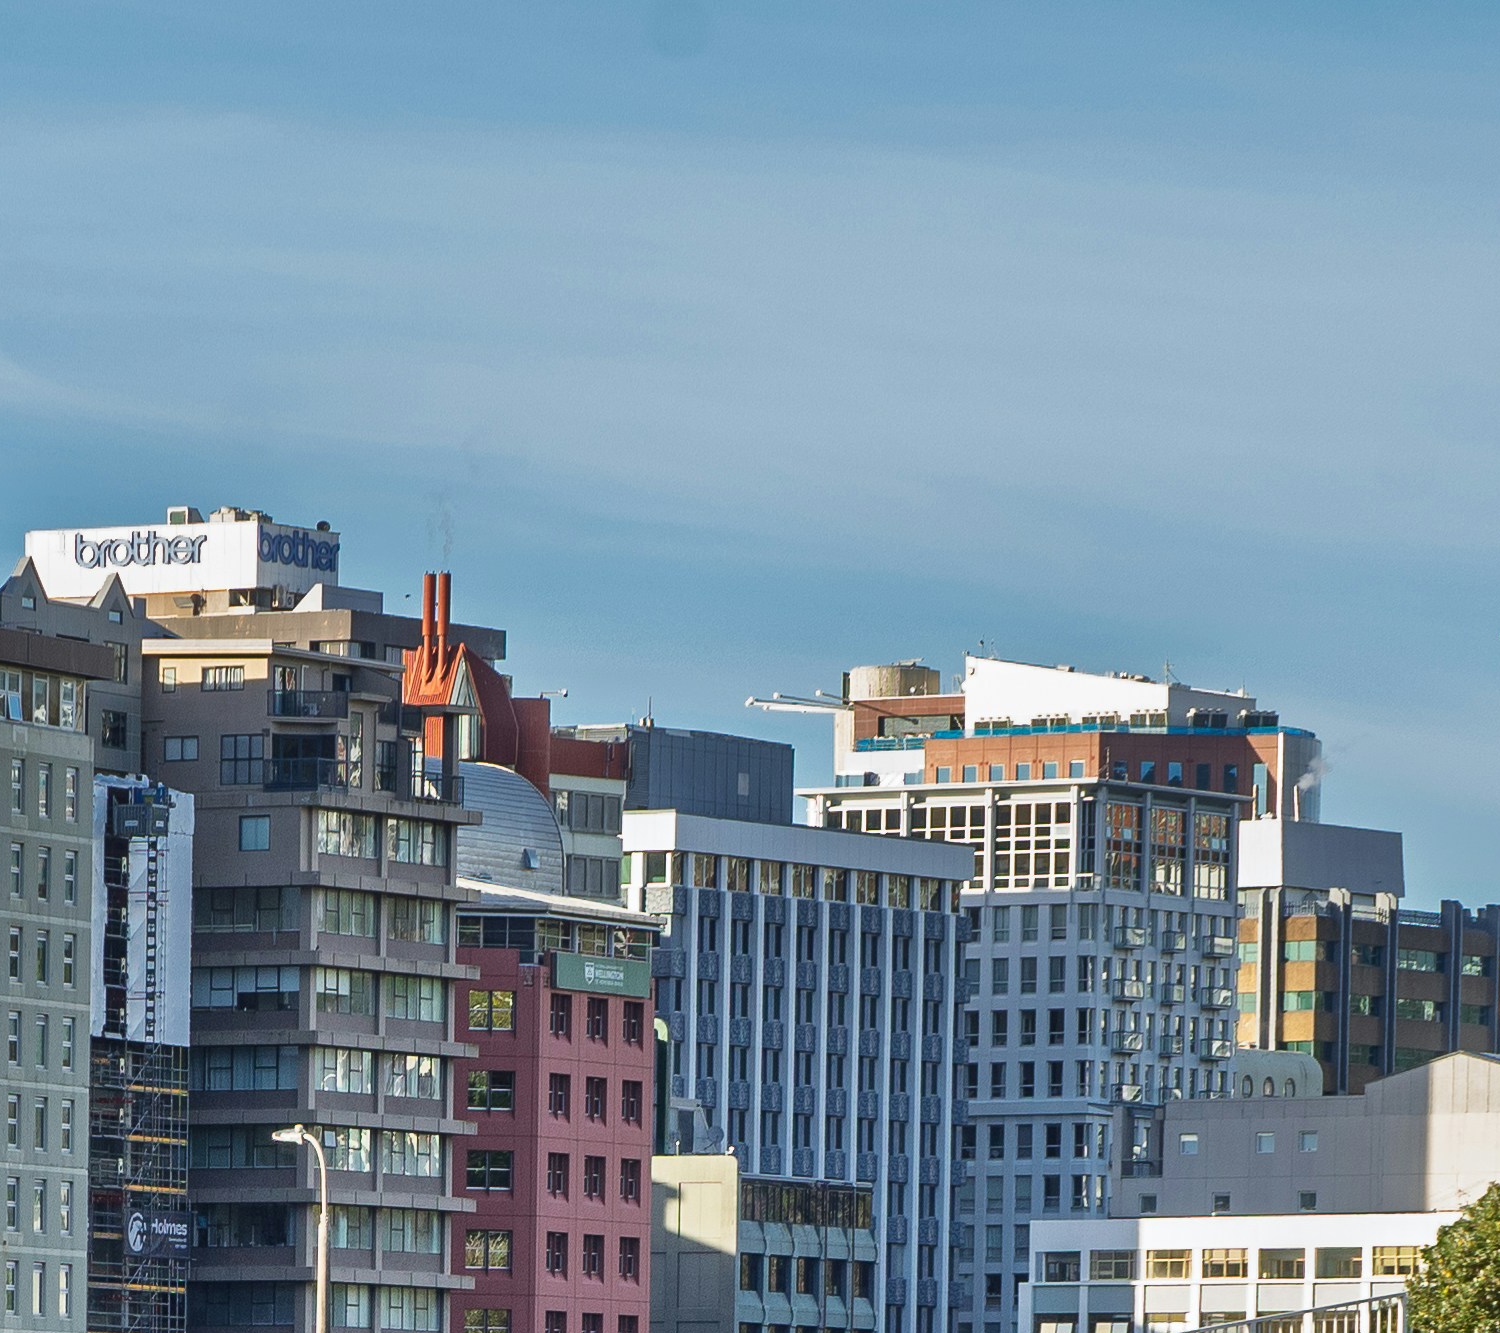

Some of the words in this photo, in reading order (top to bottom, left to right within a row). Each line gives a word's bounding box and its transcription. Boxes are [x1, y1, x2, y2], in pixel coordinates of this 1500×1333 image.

[75, 531, 207, 569] brother
[259, 525, 341, 573] brother
[151, 1218, 188, 1236] Holmes
